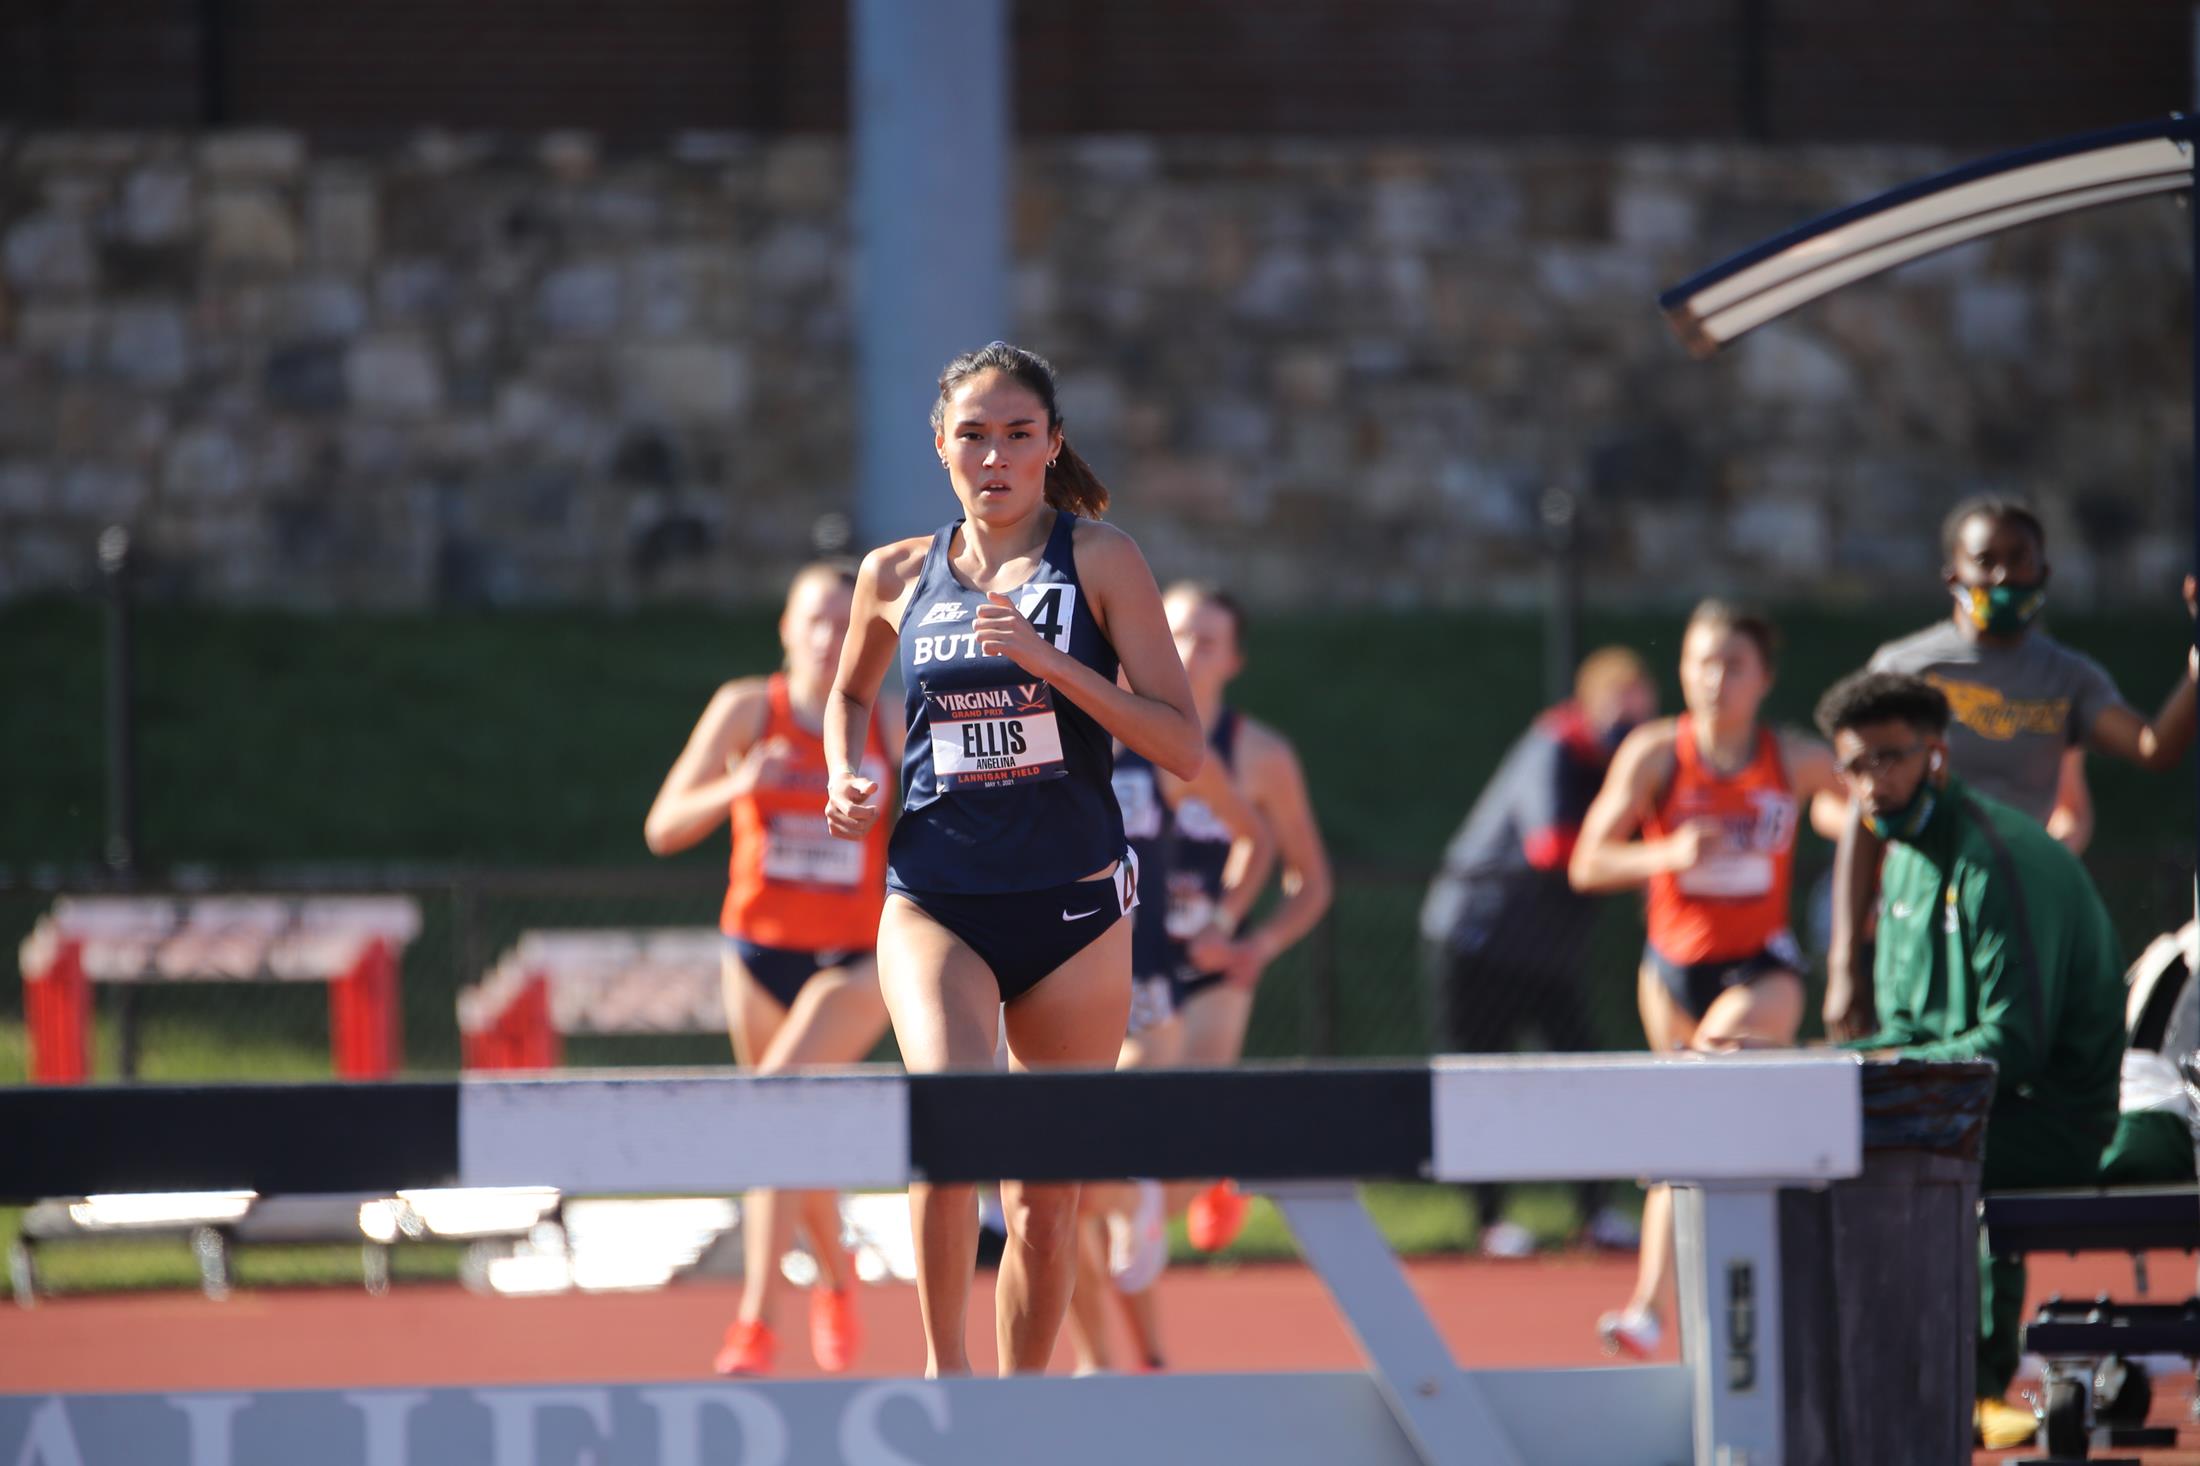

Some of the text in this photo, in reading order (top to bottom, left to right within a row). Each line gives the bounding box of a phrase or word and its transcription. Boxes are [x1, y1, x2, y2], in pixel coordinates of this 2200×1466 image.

[932, 602, 962, 611] BIG
[1026, 588, 1063, 648] 4
[913, 633, 1002, 666] BUT
[936, 690, 1014, 711] VIRGINIA
[951, 708, 1004, 719] GRAND PRIX
[962, 720, 1027, 758] ELLIS
[976, 756, 1016, 770] ANGELINA
[958, 766, 1041, 783] LANNIGAN FIELD
